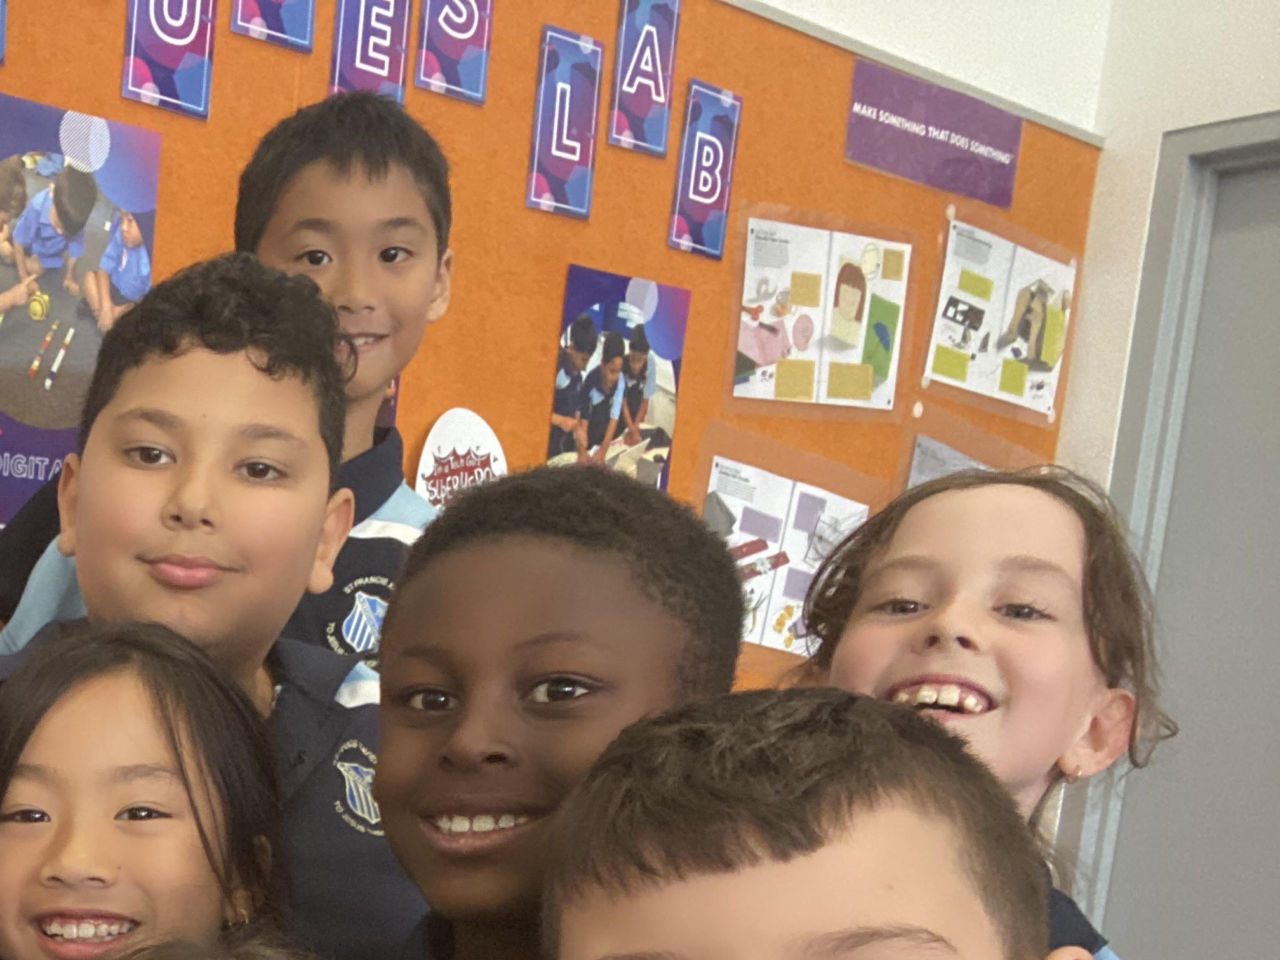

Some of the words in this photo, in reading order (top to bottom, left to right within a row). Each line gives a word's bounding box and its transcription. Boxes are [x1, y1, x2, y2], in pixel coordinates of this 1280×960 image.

[852, 102, 877, 120] MAKE
[879, 110, 926, 137] SOMETHING
[928, 126, 950, 142] THAT
[950, 133, 969, 149] DOES
